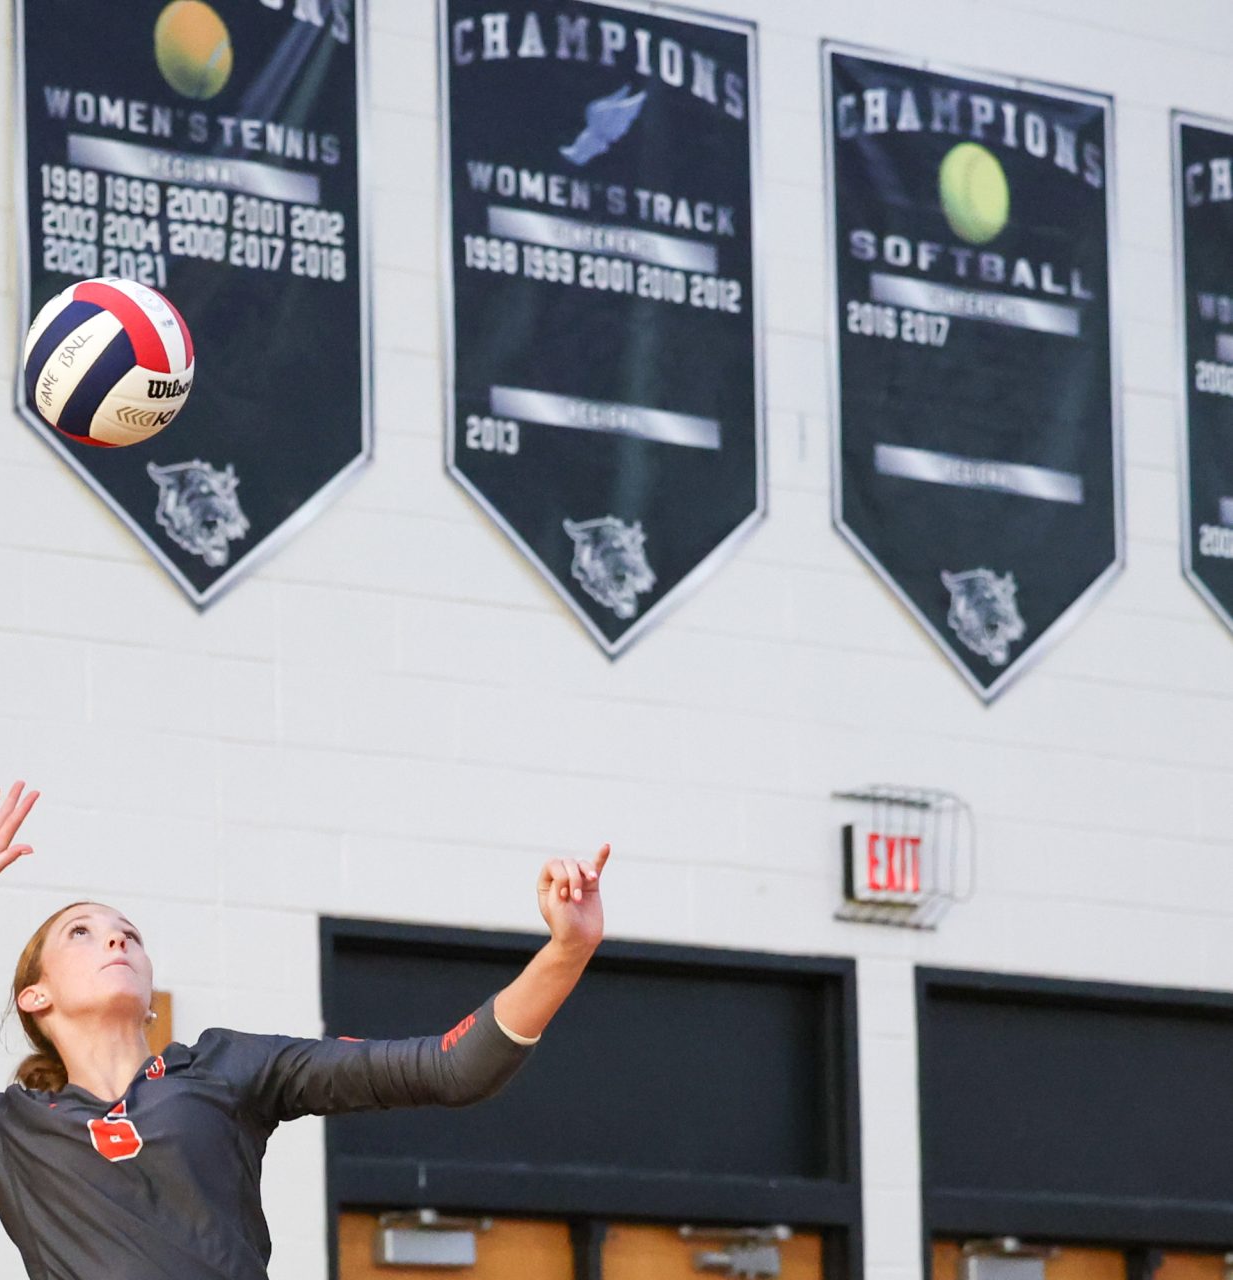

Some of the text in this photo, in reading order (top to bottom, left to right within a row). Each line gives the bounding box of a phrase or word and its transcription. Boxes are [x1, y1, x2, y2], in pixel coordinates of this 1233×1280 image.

[453, 11, 746, 120] CHAMPIONS
[44, 86, 342, 165] WOMEN'S TENNIS
[836, 86, 1104, 189] CHAMPIONS
[41, 164, 344, 246] 1998 1999 2000 2001 2002
[466, 161, 736, 237] WOMEN'S TRACK
[43, 237, 166, 288] 2020 2021
[103, 212, 161, 253] 2004
[230, 232, 285, 271] 2017
[291, 241, 346, 282] 2018
[523, 245, 576, 285] 1999
[579, 254, 634, 294] 2001
[689, 274, 742, 314] 2012
[848, 228, 1094, 301] SOFTBALL
[900, 310, 951, 348] 2017
[41, 334, 95, 407] GAME BALL
[147, 378, 193, 399] Wilso
[868, 832, 921, 893] EXIT
